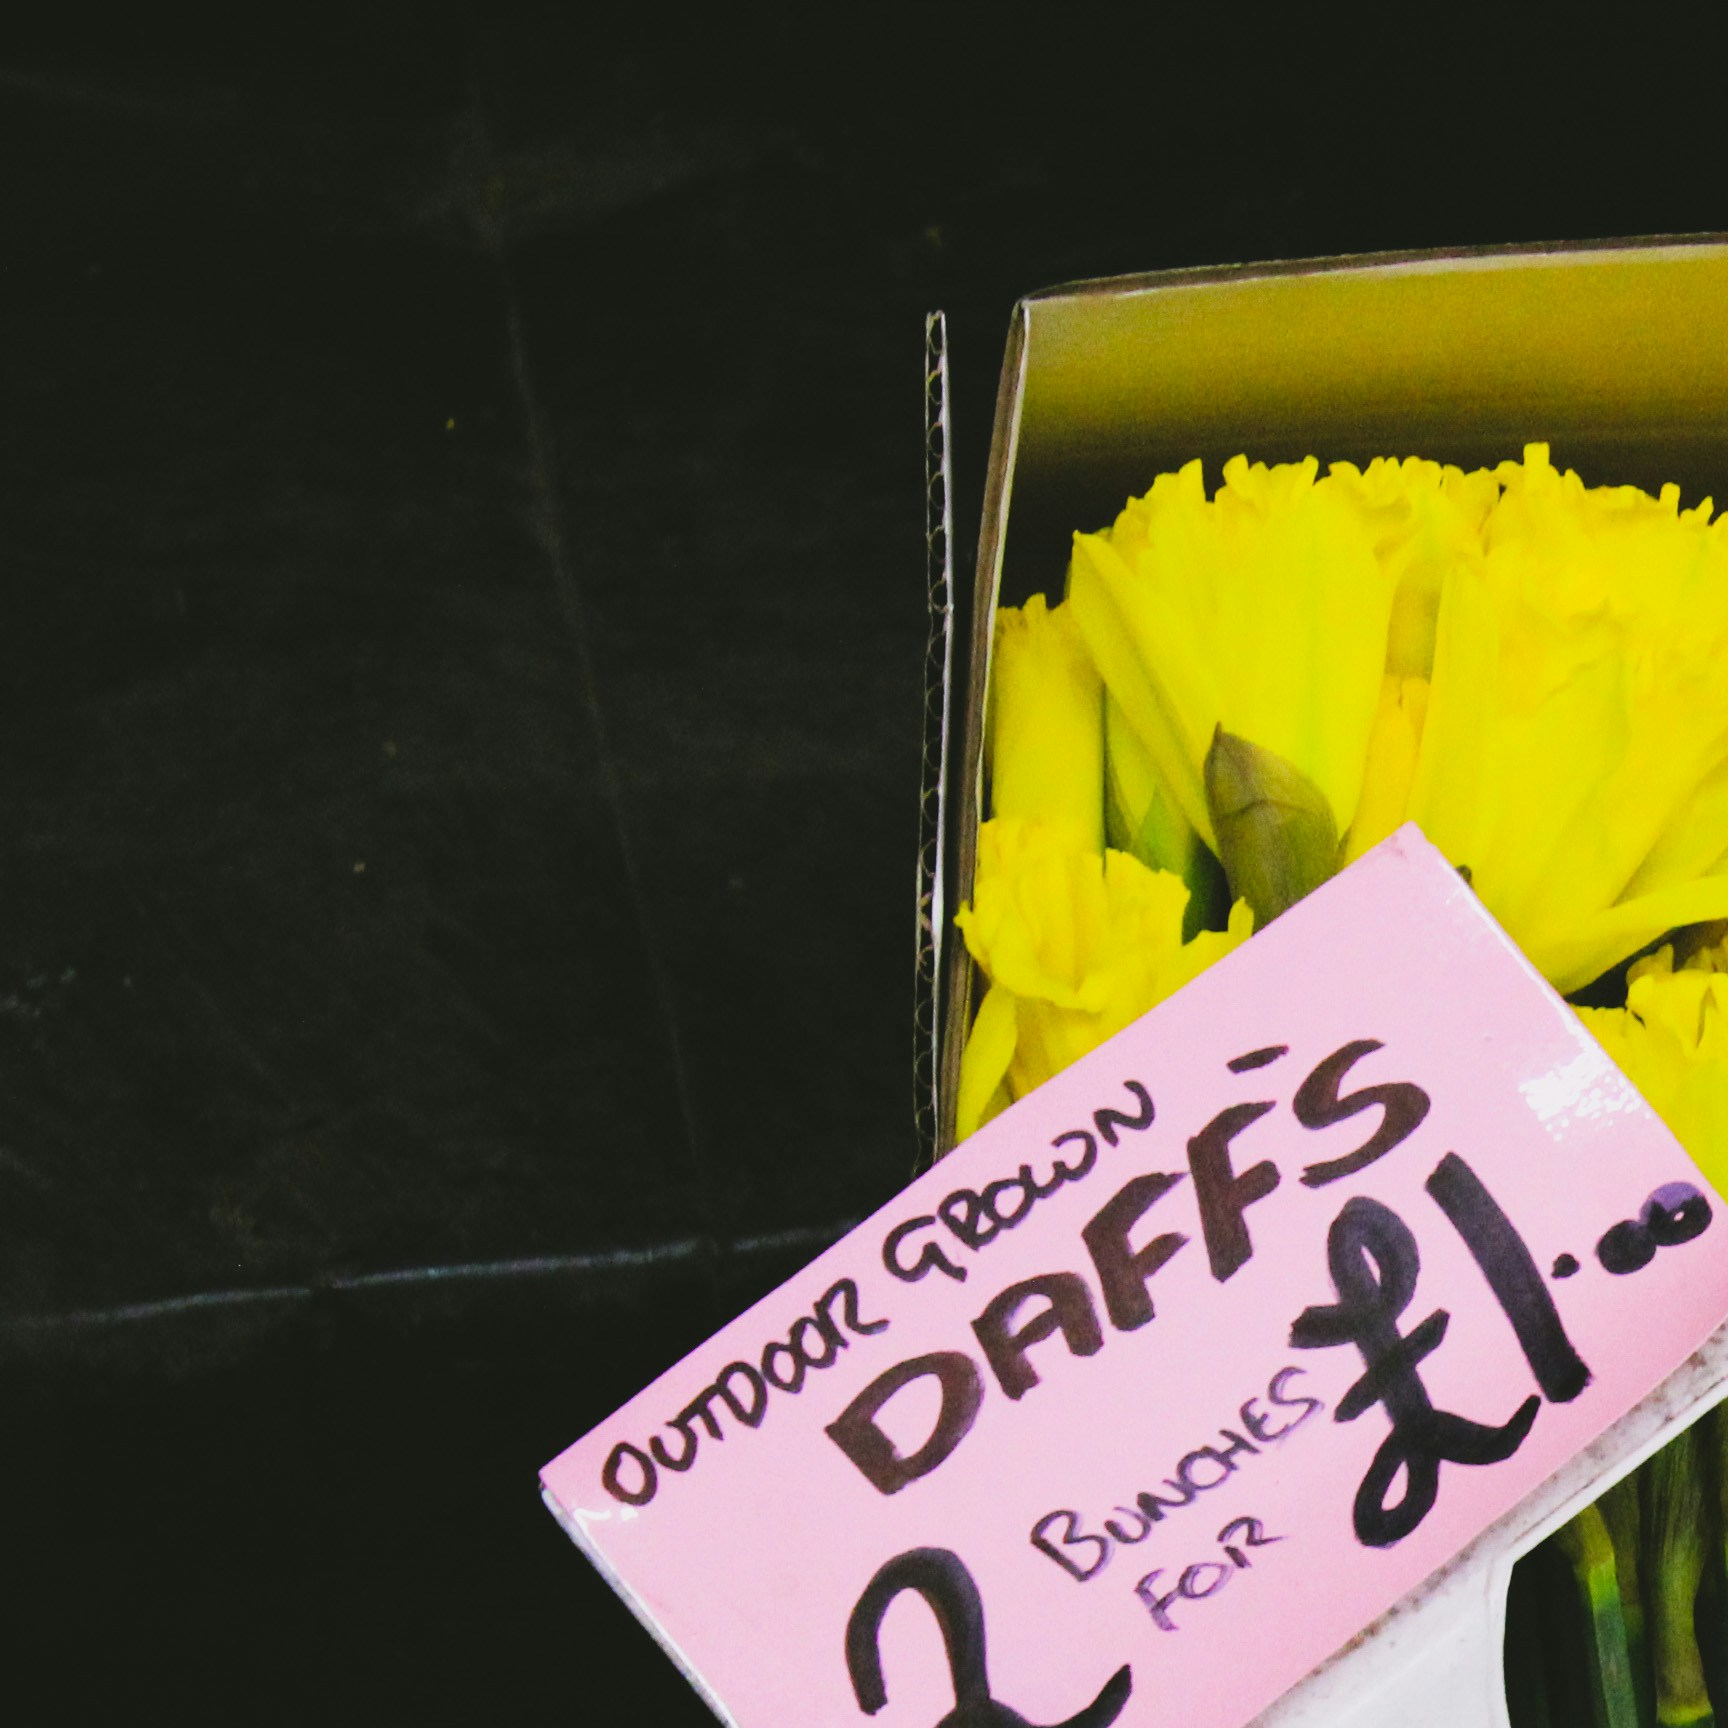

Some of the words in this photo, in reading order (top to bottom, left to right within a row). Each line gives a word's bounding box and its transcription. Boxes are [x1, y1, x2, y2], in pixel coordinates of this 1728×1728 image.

[602, 1278, 890, 1506] OUTDOOR
[882, 1080, 1155, 1282] GROWN
[1031, 1366, 1324, 1582] BUNCHES
[1133, 1516, 1287, 1632] FOR
